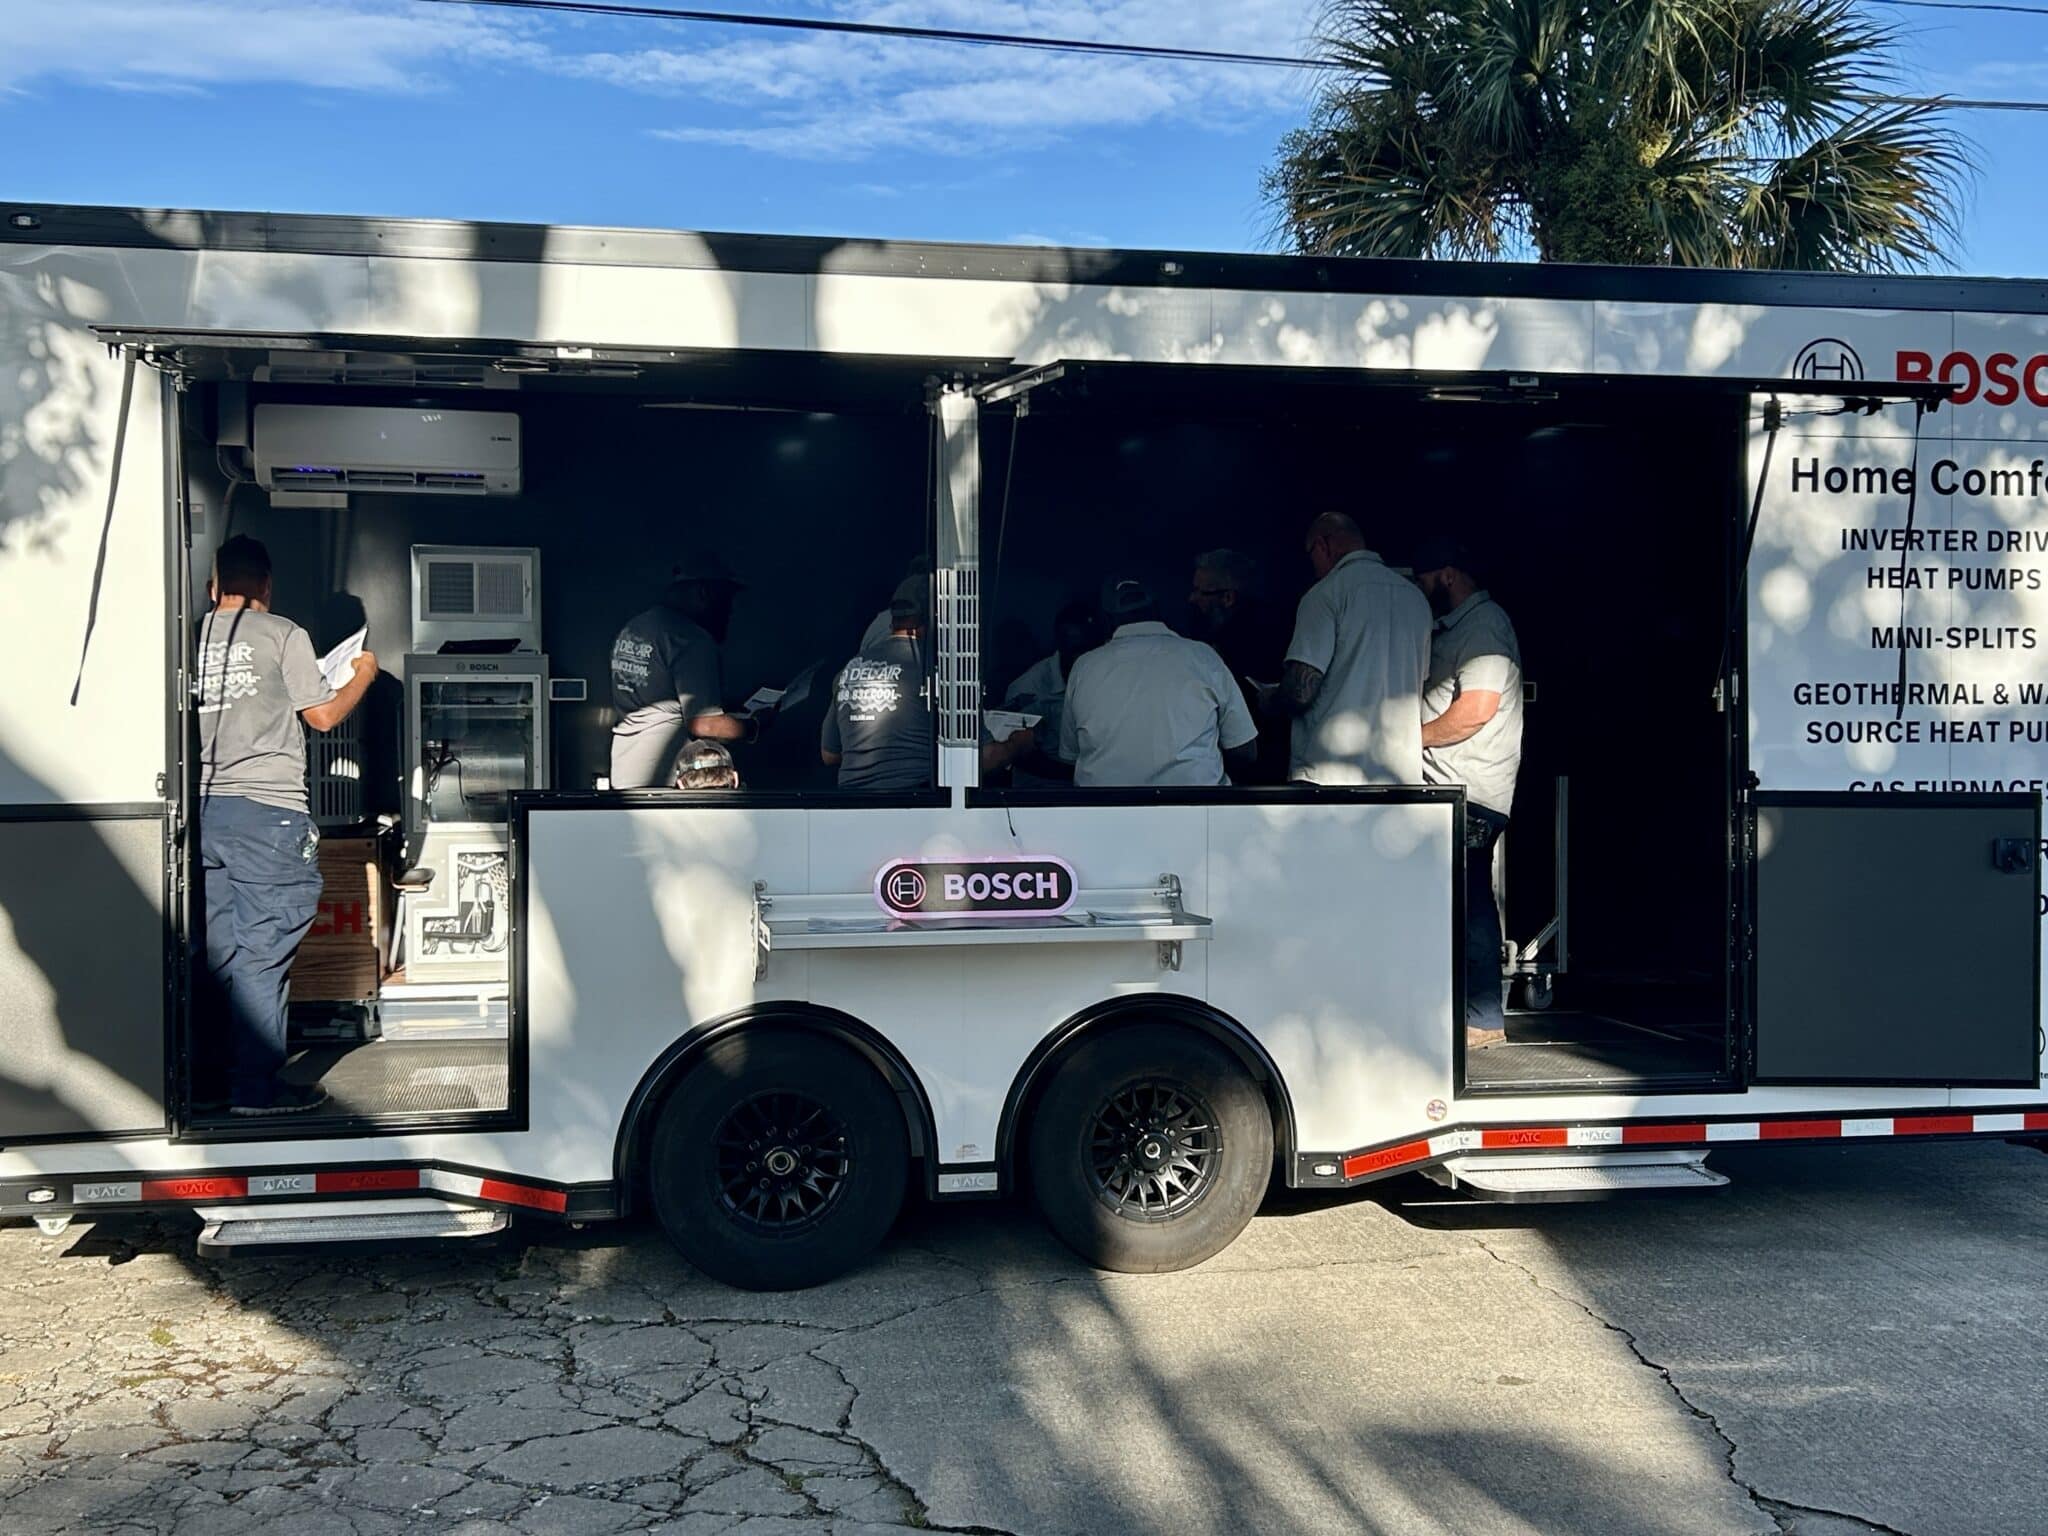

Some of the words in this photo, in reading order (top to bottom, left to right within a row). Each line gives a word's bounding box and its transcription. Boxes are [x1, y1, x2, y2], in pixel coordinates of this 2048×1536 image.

[1792, 457, 1914, 494] Home
[1931, 459, 2048, 496] Comf
[1842, 529, 1978, 552] INVERTER
[1867, 567, 1939, 589] HEAT
[1948, 567, 2041, 590] PUMPS
[1872, 627, 2037, 649] MINI-SPLITS
[1793, 683, 1984, 705] GEOTHERMAL
[1993, 683, 2009, 705] &
[2018, 683, 2048, 705] W
[1806, 721, 1921, 744] SOURCE
[1930, 721, 2000, 743] HEAT
[2009, 721, 2048, 743] PU
[1915, 780, 2048, 793] FURNACE
[943, 872, 1058, 901] BOSCH
[101, 1186, 127, 1197] ATC
[189, 1182, 215, 1193] ATC
[276, 1178, 301, 1189] ATC
